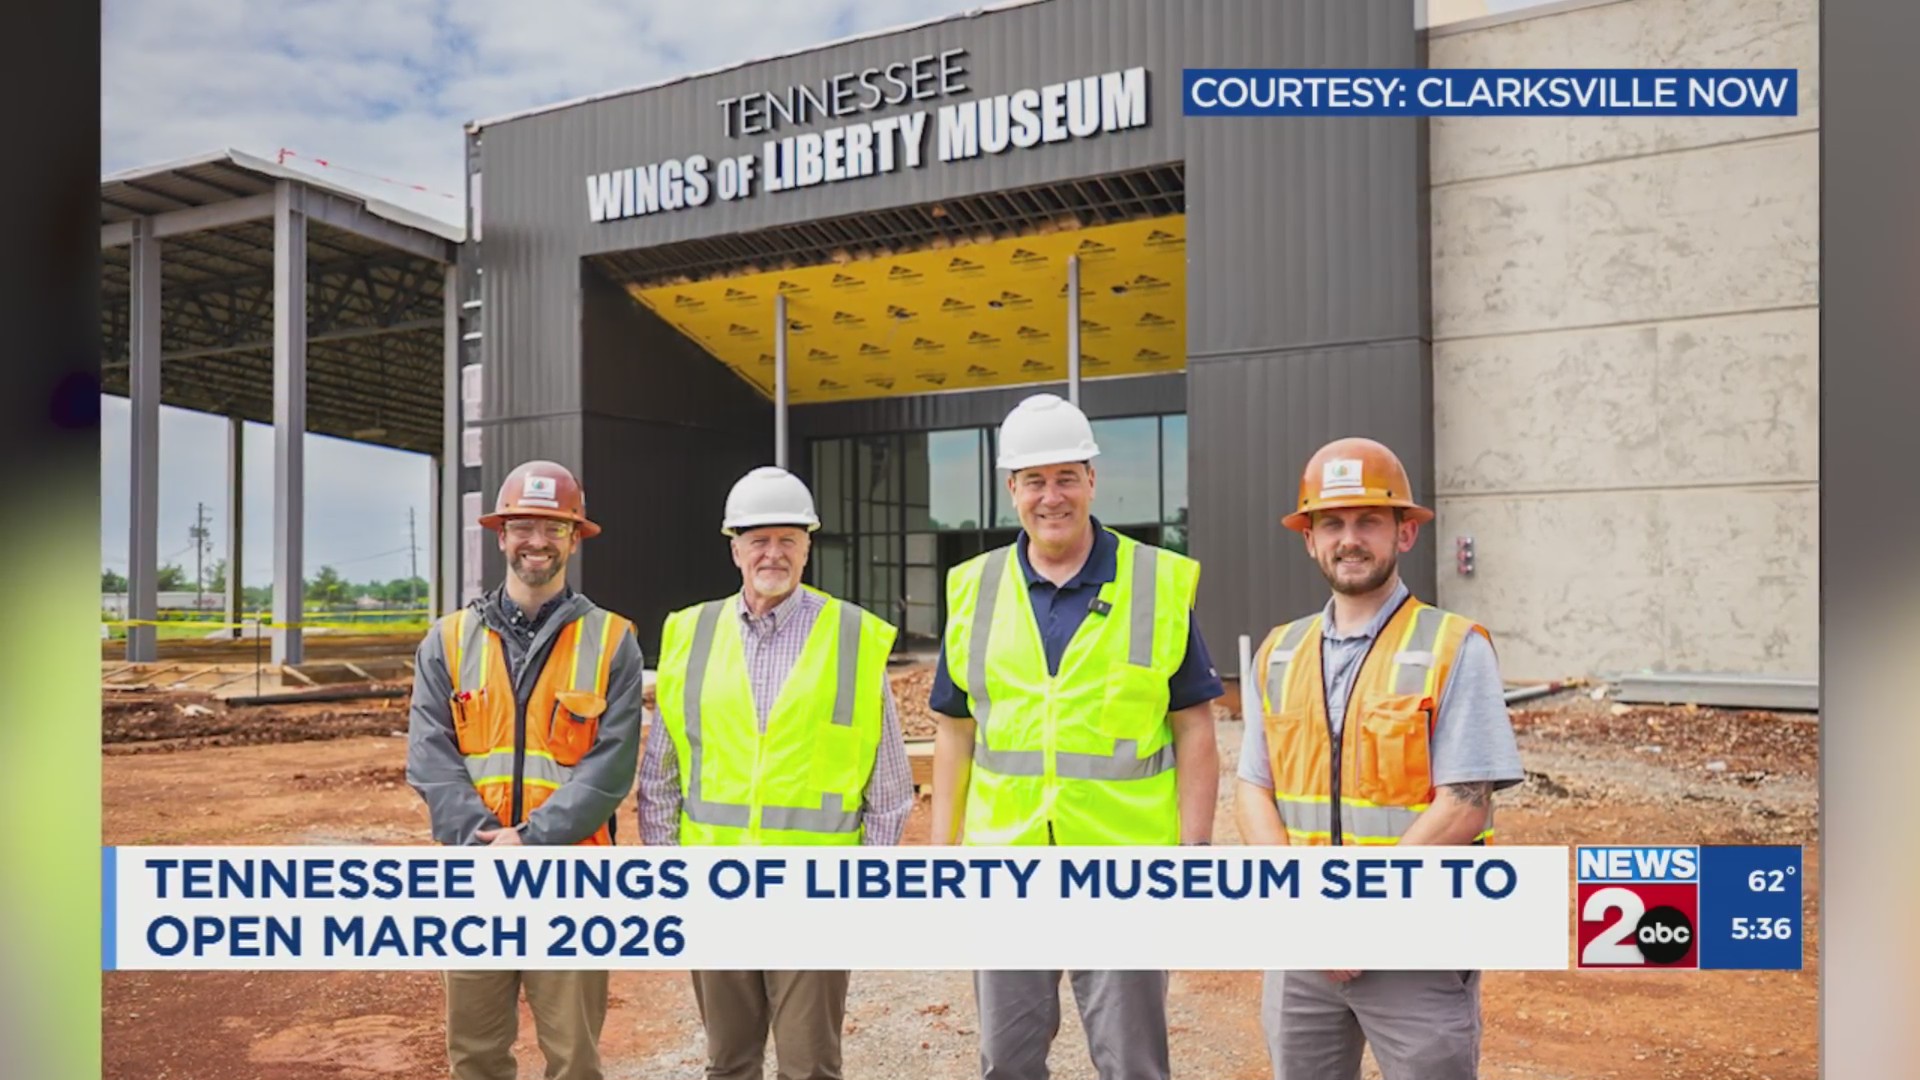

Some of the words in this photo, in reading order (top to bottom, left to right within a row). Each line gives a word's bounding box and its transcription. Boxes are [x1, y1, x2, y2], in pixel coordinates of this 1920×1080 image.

[586, 154, 709, 222] WINGS
[717, 155, 754, 200] OF
[763, 111, 928, 193] LIBERTY
[938, 66, 1147, 161] MUSEUM
[717, 48, 966, 136] TENNESSEE
